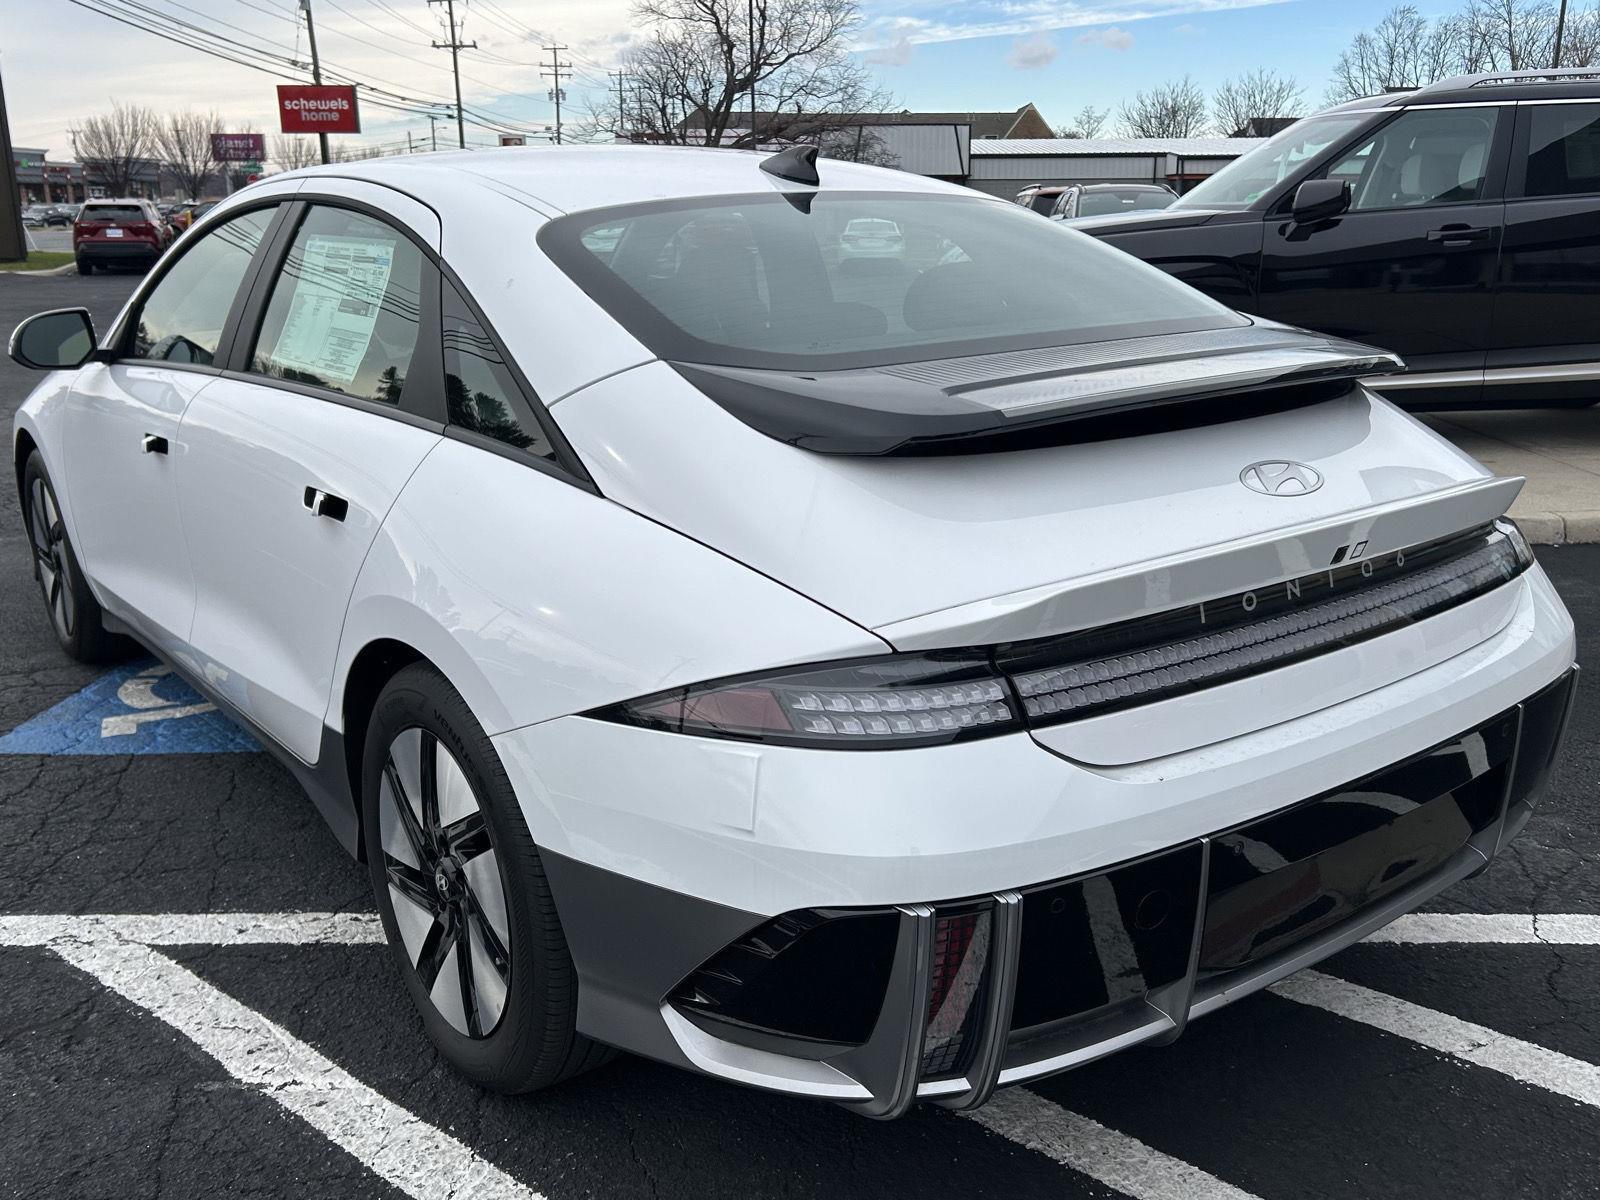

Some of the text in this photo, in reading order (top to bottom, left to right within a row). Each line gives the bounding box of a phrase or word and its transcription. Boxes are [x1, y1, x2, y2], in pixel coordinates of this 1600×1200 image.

[284, 98, 349, 110] schewels
[301, 110, 340, 122] home
[1396, 550, 1405, 567] 6
